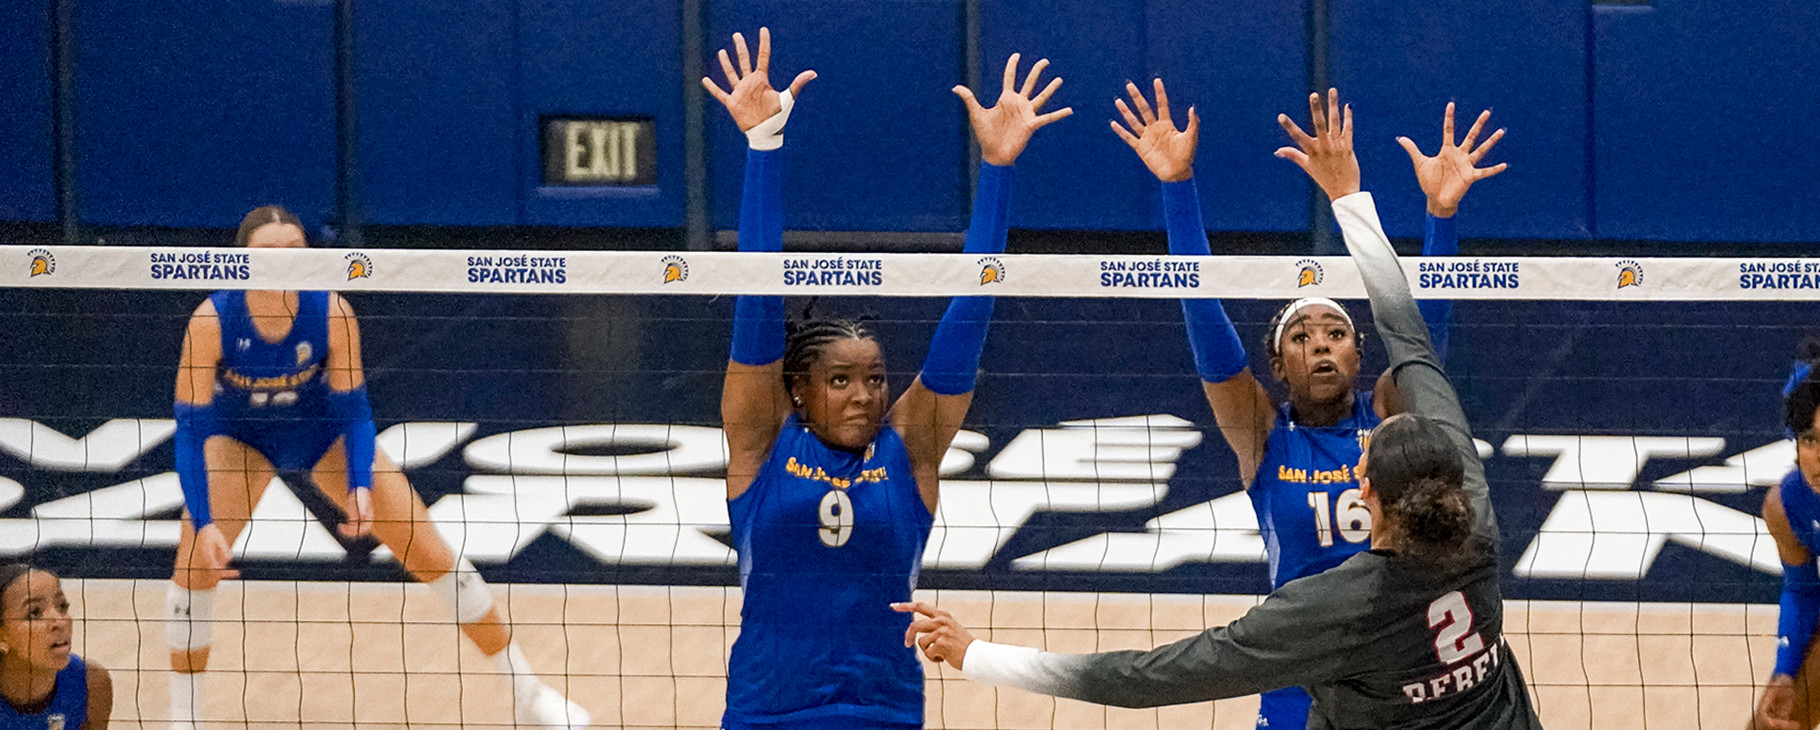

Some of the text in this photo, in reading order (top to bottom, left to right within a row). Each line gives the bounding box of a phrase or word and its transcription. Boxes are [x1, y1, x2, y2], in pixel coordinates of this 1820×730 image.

[565, 121, 640, 180] EXIT
[151, 251, 250, 264] SAN JOSÉ STATE
[468, 255, 566, 268] SAN JOSÉ STATE
[784, 257, 882, 270] SAN JOSÉ STATE
[1100, 259, 1200, 272] SAN JOSÉ STATE
[151, 264, 250, 280] SPARTANS
[1419, 260, 1519, 272] SAN JOSÉ STATE
[1740, 260, 1820, 273] SAN JOSÉ ST
[468, 267, 567, 283] SPARTANS
[784, 270, 883, 286] SPARTANS
[1100, 272, 1200, 288] SPARTANS
[1419, 273, 1520, 289] SPARTANS
[785, 456, 813, 479] SAN
[1278, 464, 1307, 484] SAN
[1311, 463, 1351, 485] JOSÉ
[818, 489, 855, 548] 9
[1307, 488, 1372, 547] 16
[1426, 590, 1484, 665] 2
